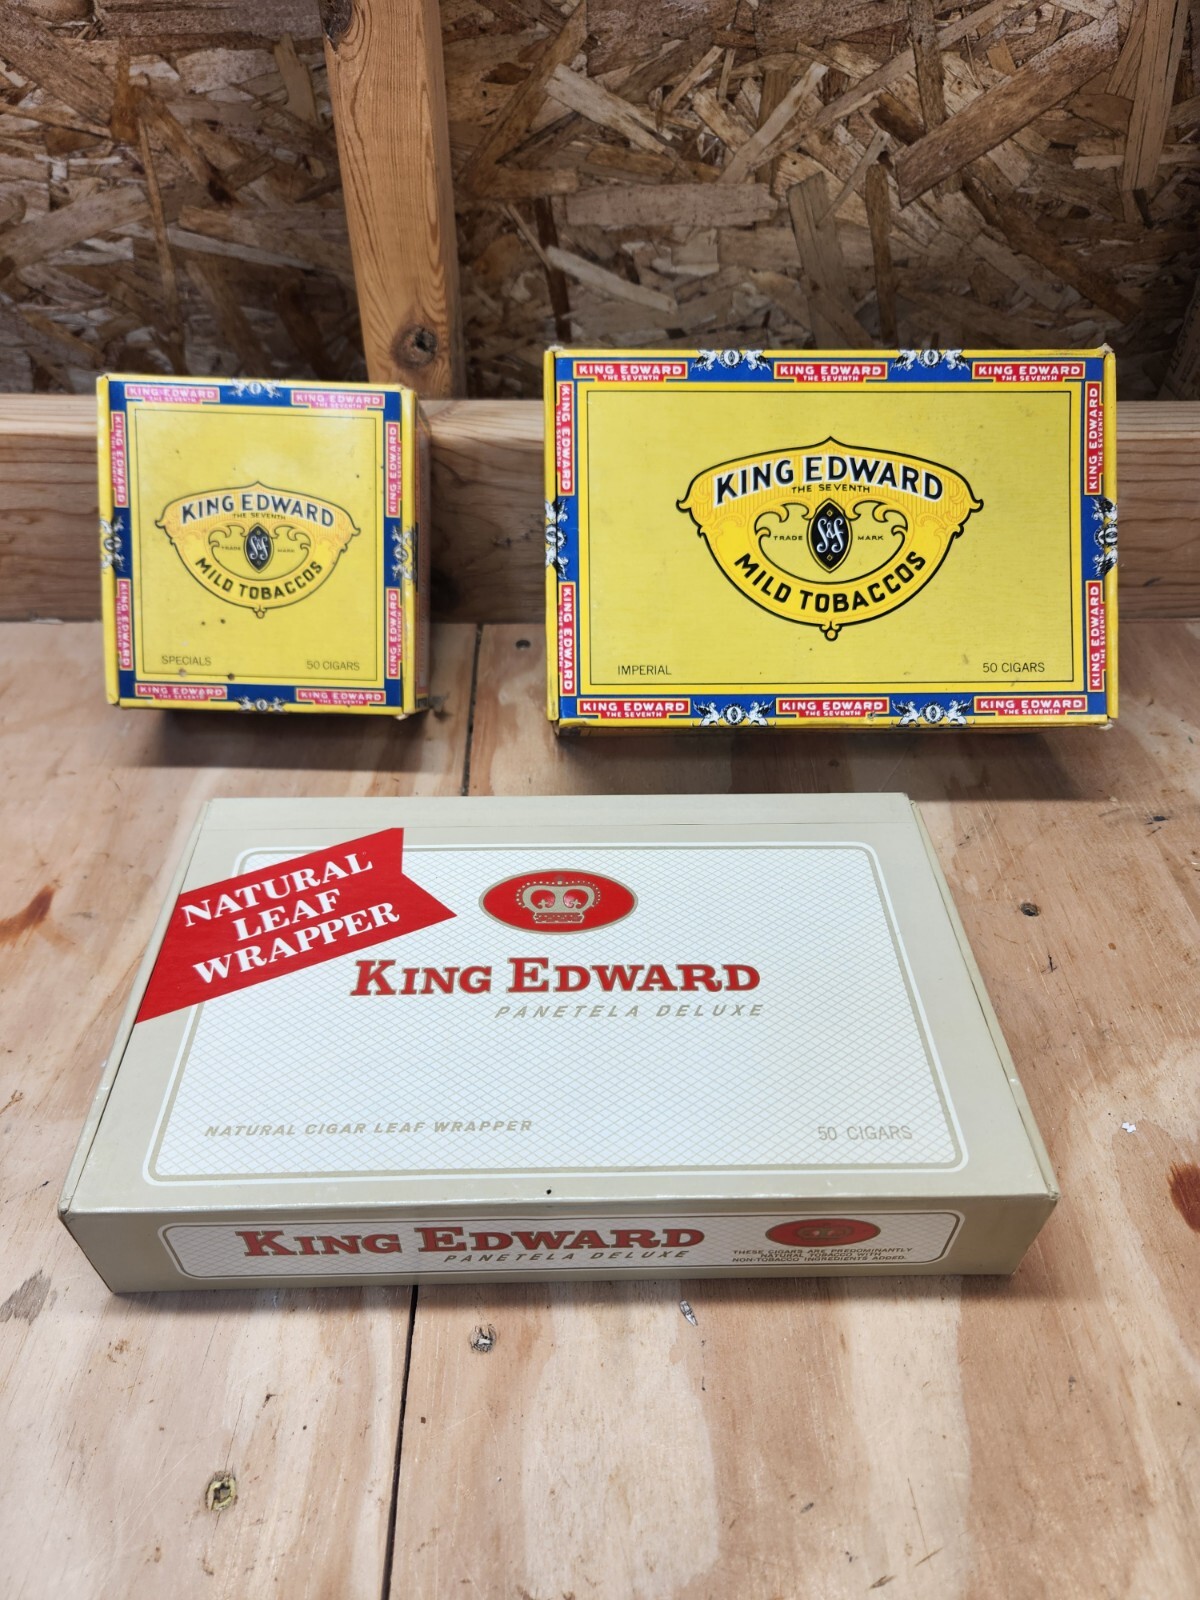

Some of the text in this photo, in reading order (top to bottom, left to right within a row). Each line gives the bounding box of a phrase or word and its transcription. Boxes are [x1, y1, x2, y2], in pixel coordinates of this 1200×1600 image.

[578, 364, 683, 375] KING EDWARD
[780, 366, 882, 375] KING EDWARD
[978, 365, 1080, 375] KING EDWARD
[129, 387, 215, 398] KING EDWARD
[296, 394, 380, 404] KING EDWARD
[561, 385, 571, 490] KING EDWARD
[1089, 388, 1098, 490] KING EDWARD
[116, 450, 125, 503] EDWARD
[714, 455, 944, 506] KING EDWARD
[792, 483, 870, 494] THE SEVENTH
[182, 494, 334, 527] KING EDWARD
[195, 557, 322, 600] MILD TOBACCOS
[734, 551, 926, 613] MILD TOBACCOS
[120, 582, 130, 666] KING EDWARD
[563, 587, 573, 690] KING EDWARD
[1090, 586, 1100, 687] KING EDWARD
[161, 654, 211, 667] SPECIALS
[306, 660, 360, 671] 50 CIGARS
[982, 662, 1045, 673] 50 CIGARS
[617, 665, 672, 676] IMPERIAL
[172, 687, 223, 696] EDWARD
[300, 691, 382, 701] KING EDWARD
[582, 702, 685, 712] KING EDWARD
[782, 701, 883, 710] KING EDWARD
[980, 699, 1083, 709] KING EDWARD
[181, 852, 373, 927] NATURAL
[233, 889, 341, 942] LEAF
[192, 902, 400, 984] WRAPPER
[350, 957, 761, 996] KING EDWARD
[494, 1004, 763, 1019] PANETELA DELUXE
[204, 1120, 533, 1137] NATURAL CIGAR LEAF WRAPPER
[818, 1125, 913, 1141] 50 CIGARS
[234, 1226, 706, 1257] KING EDWARD
[444, 1250, 690, 1263] PANETELA DELUXE
